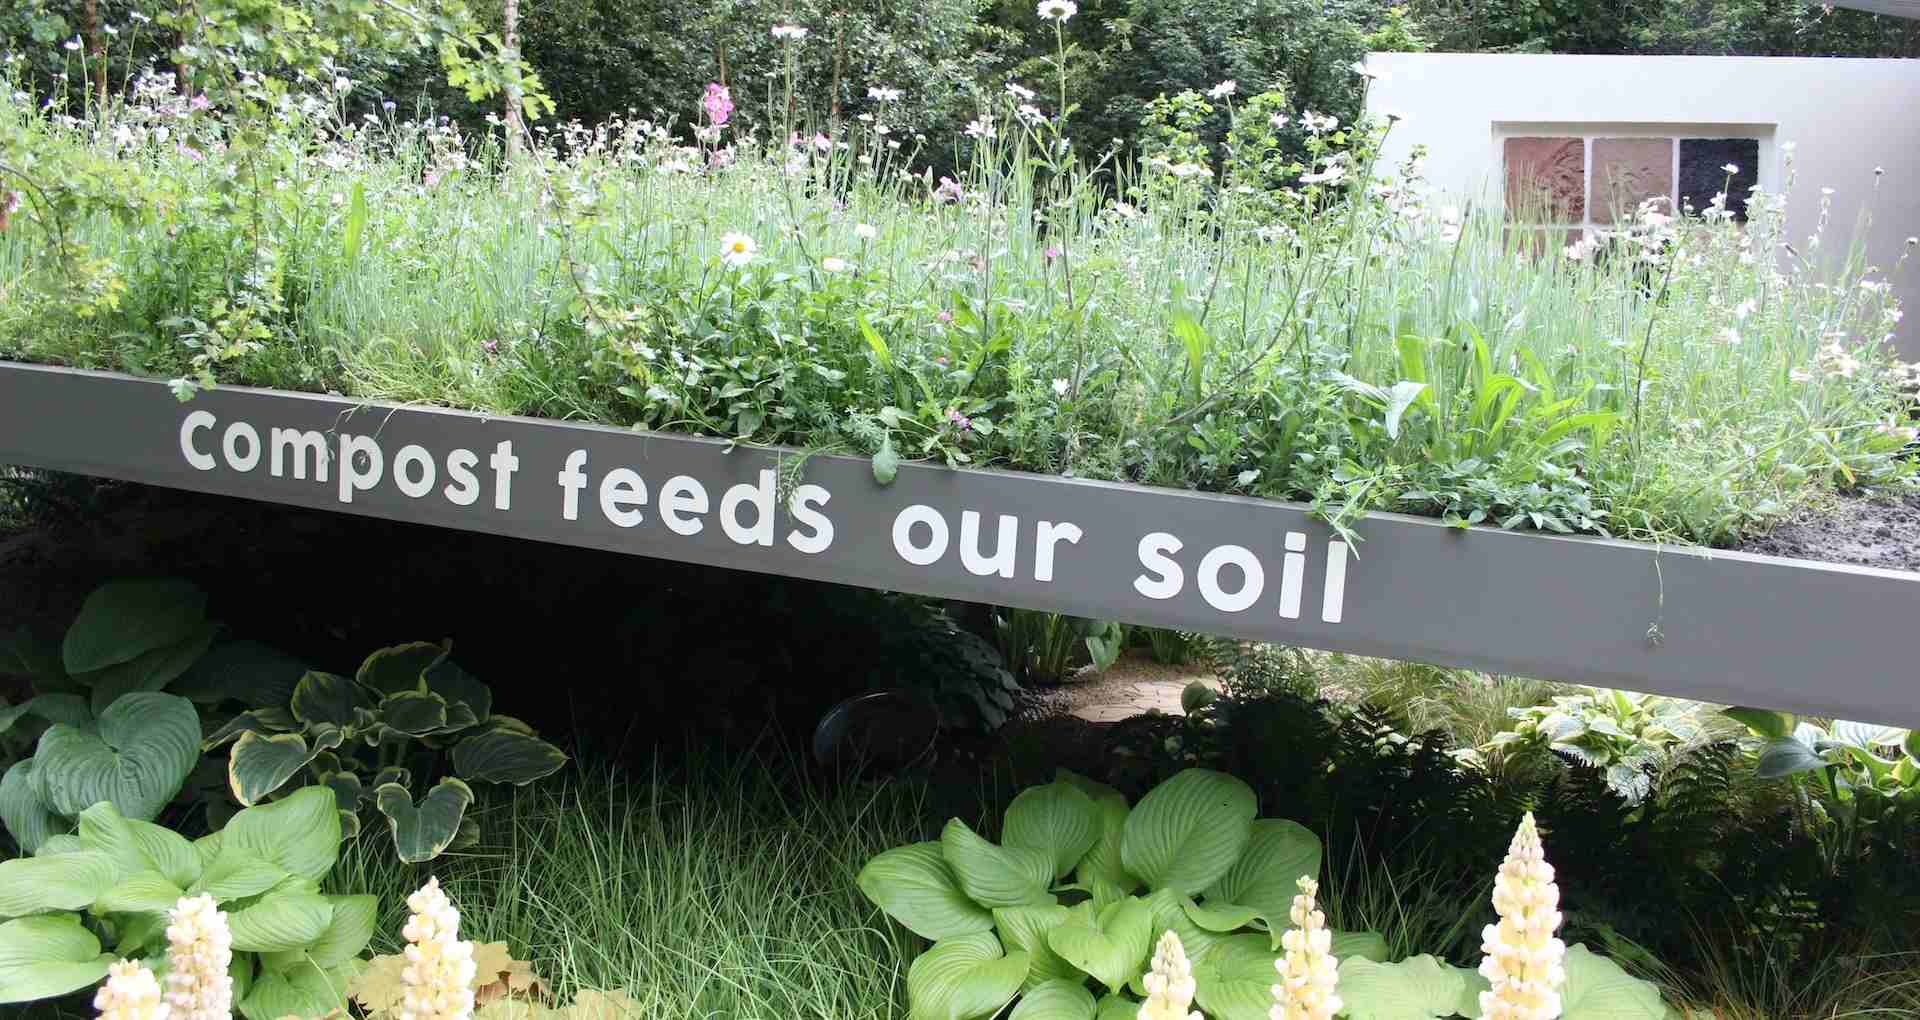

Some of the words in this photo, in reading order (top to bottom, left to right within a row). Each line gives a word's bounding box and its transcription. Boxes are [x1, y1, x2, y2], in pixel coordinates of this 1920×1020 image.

[180, 410, 519, 510] compost
[558, 449, 834, 554] feeds
[892, 504, 1083, 582] our
[1133, 531, 1348, 624] soil
